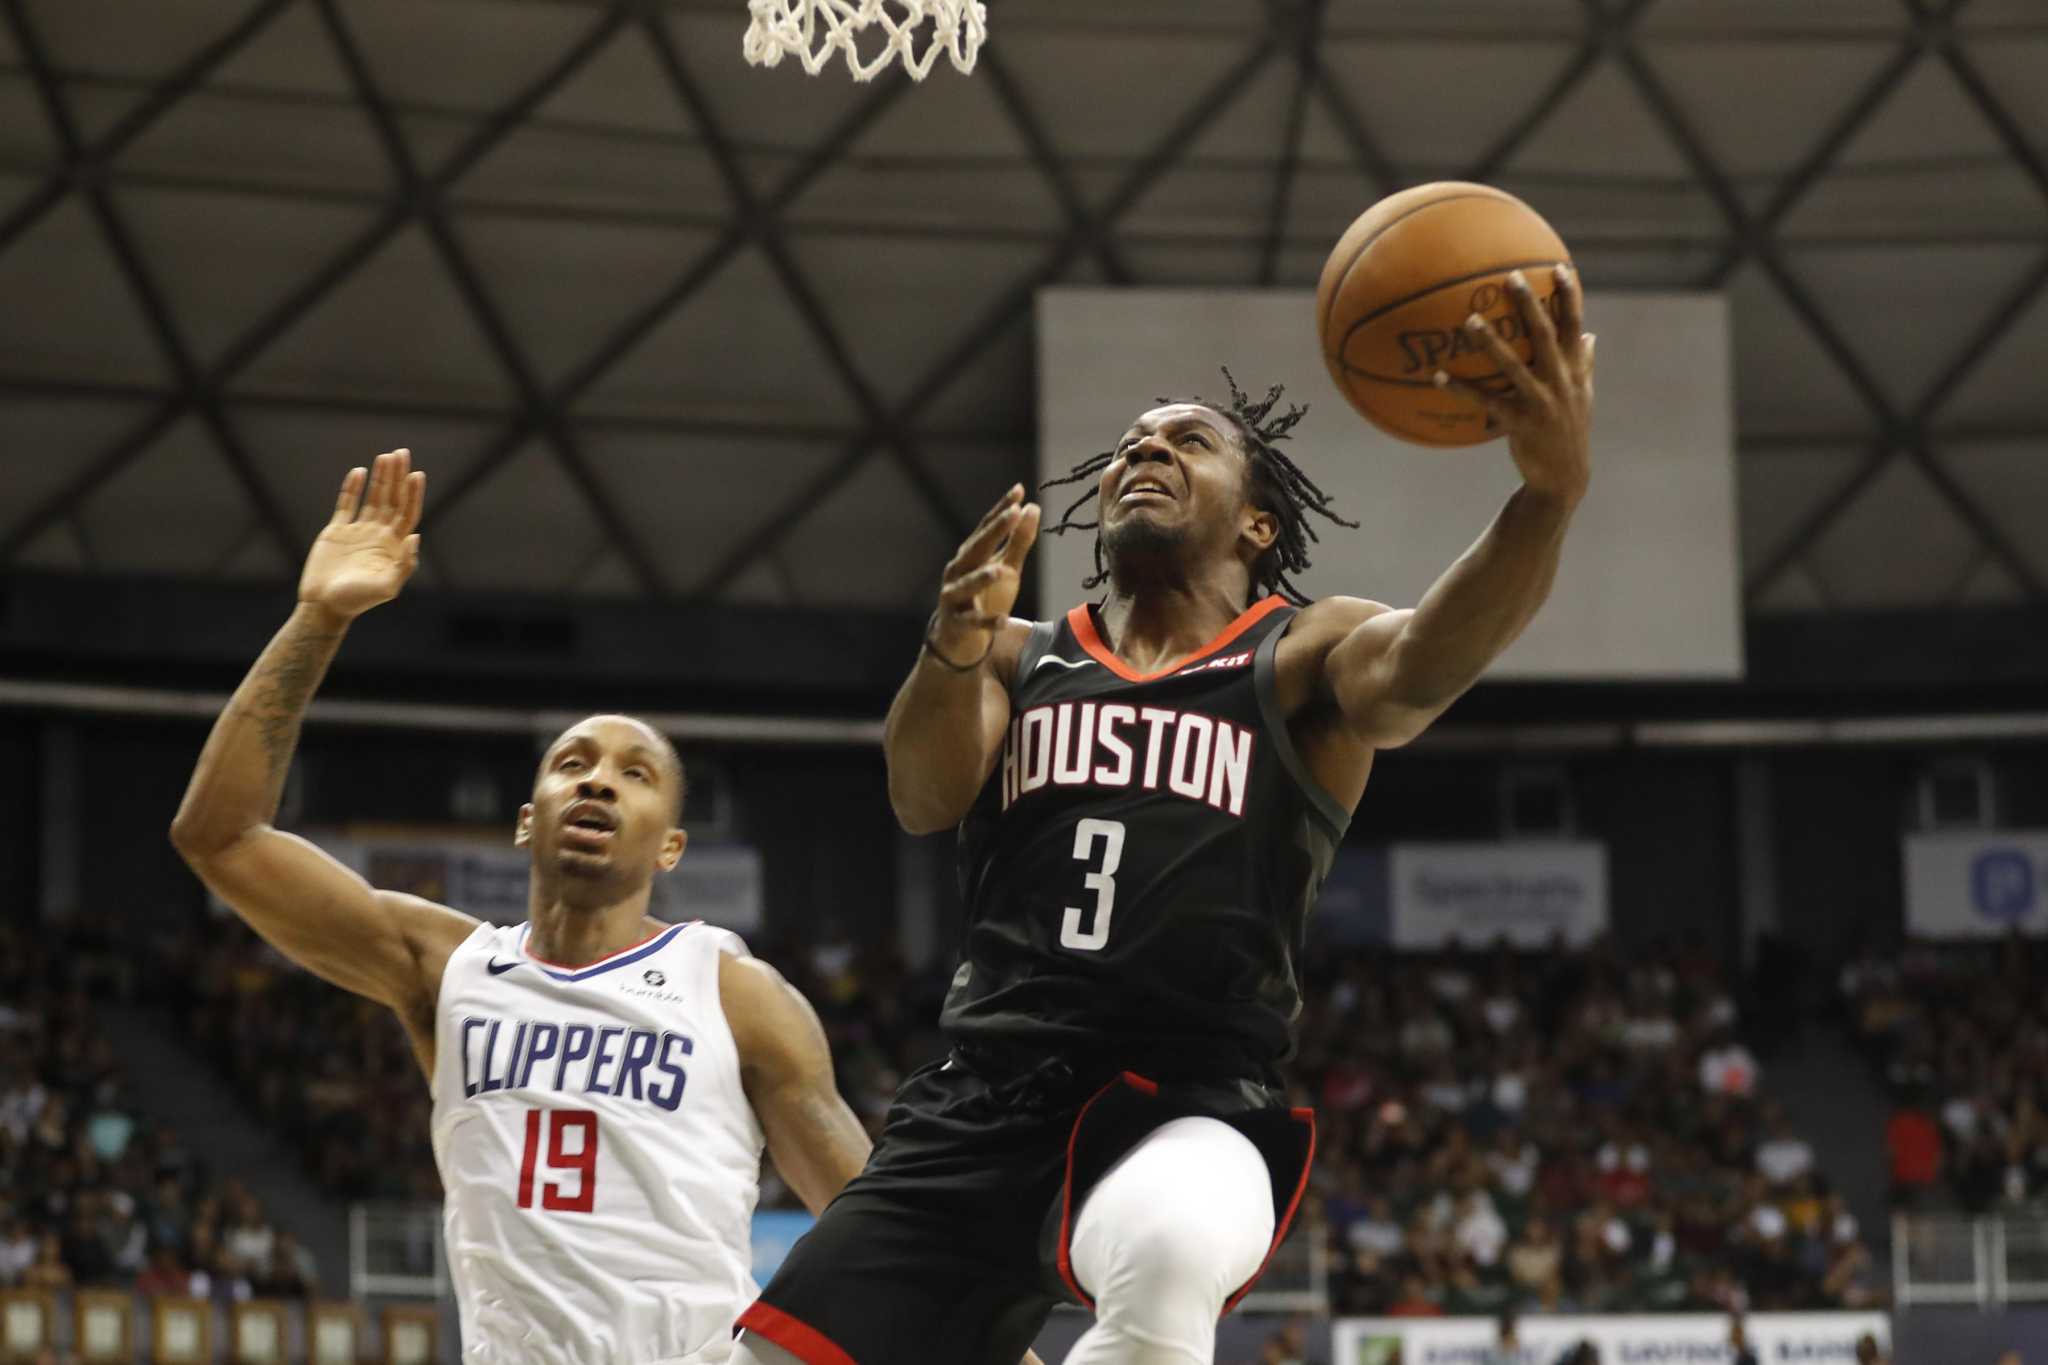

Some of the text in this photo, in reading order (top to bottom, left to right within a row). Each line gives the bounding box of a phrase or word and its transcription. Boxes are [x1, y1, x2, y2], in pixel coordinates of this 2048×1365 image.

[1001, 702, 1253, 817] HOUSTON
[1060, 817, 1127, 951] 3
[462, 1016, 695, 1113] CLIPPERS
[517, 1108, 599, 1214] 19
